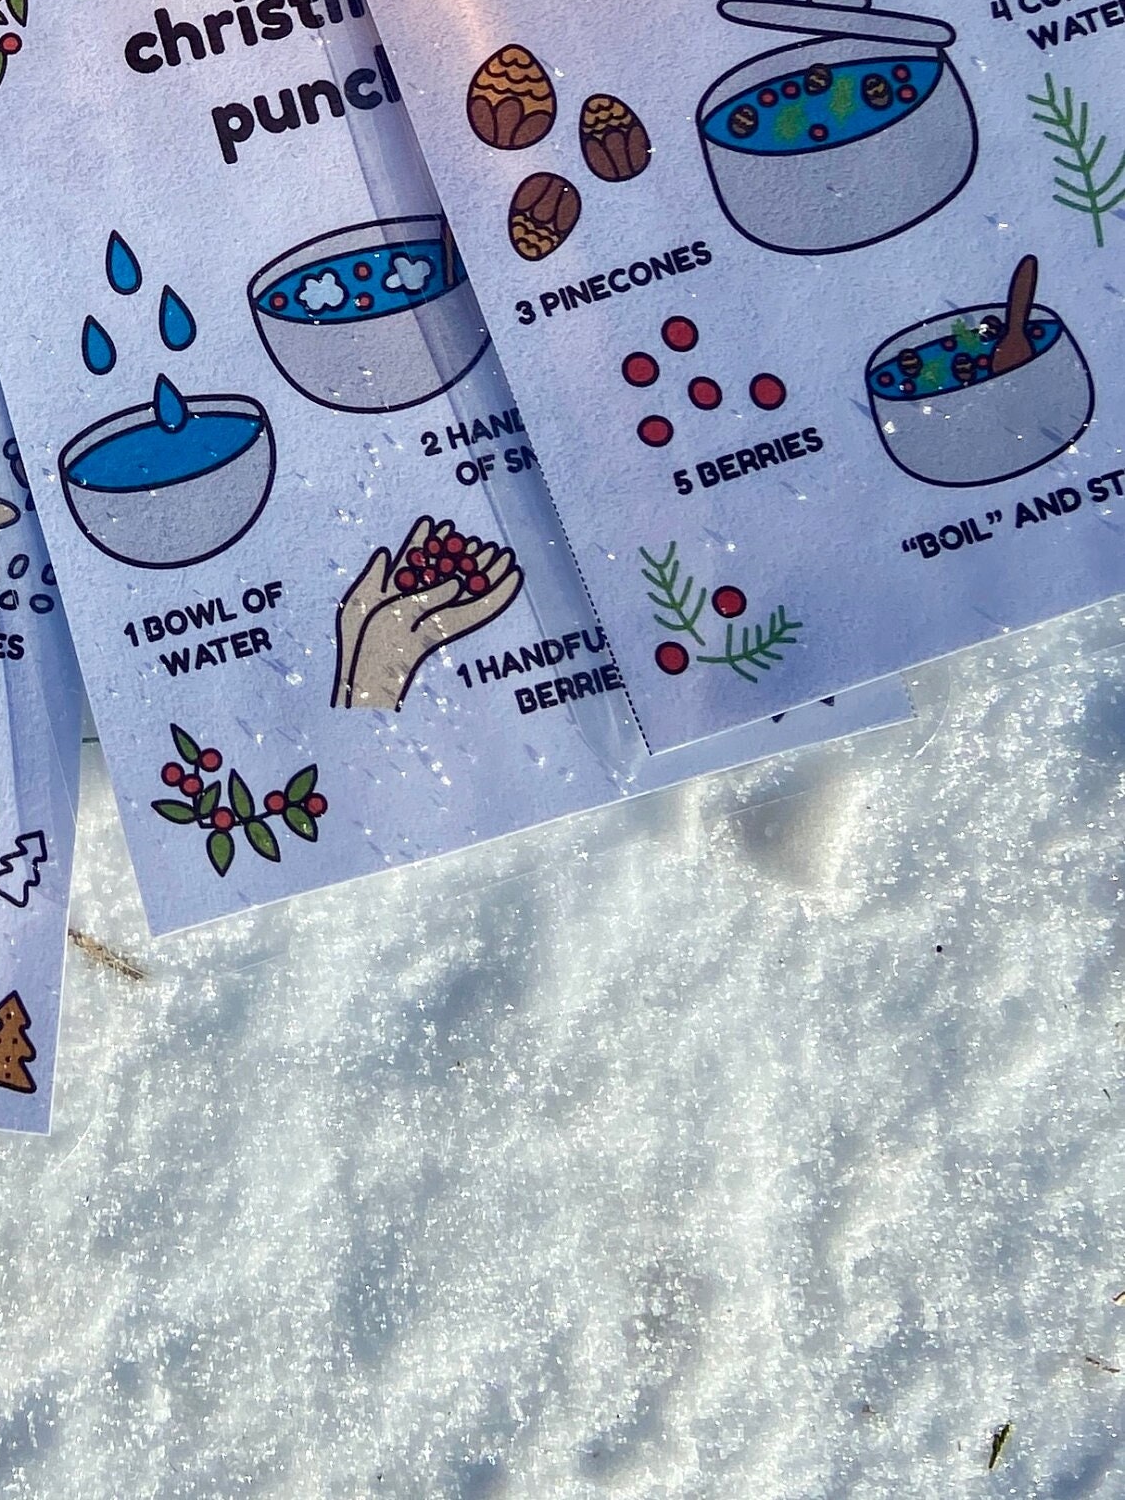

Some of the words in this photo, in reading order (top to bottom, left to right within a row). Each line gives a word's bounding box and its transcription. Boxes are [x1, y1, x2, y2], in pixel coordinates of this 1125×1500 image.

[991, 0, 1013, 21] 4
[516, 301, 536, 325] 3
[540, 241, 711, 317] PINECONES
[421, 431, 442, 456] 2
[674, 469, 693, 495] 5
[696, 428, 823, 487] BERRIES
[456, 454, 495, 486] OF
[1016, 488, 1081, 528] AND
[124, 622, 139, 647] 1
[143, 598, 237, 642] BOWL
[243, 581, 282, 613] OF
[160, 628, 272, 676] WATER
[457, 664, 472, 688] 1
[515, 663, 625, 714] BERRIE
